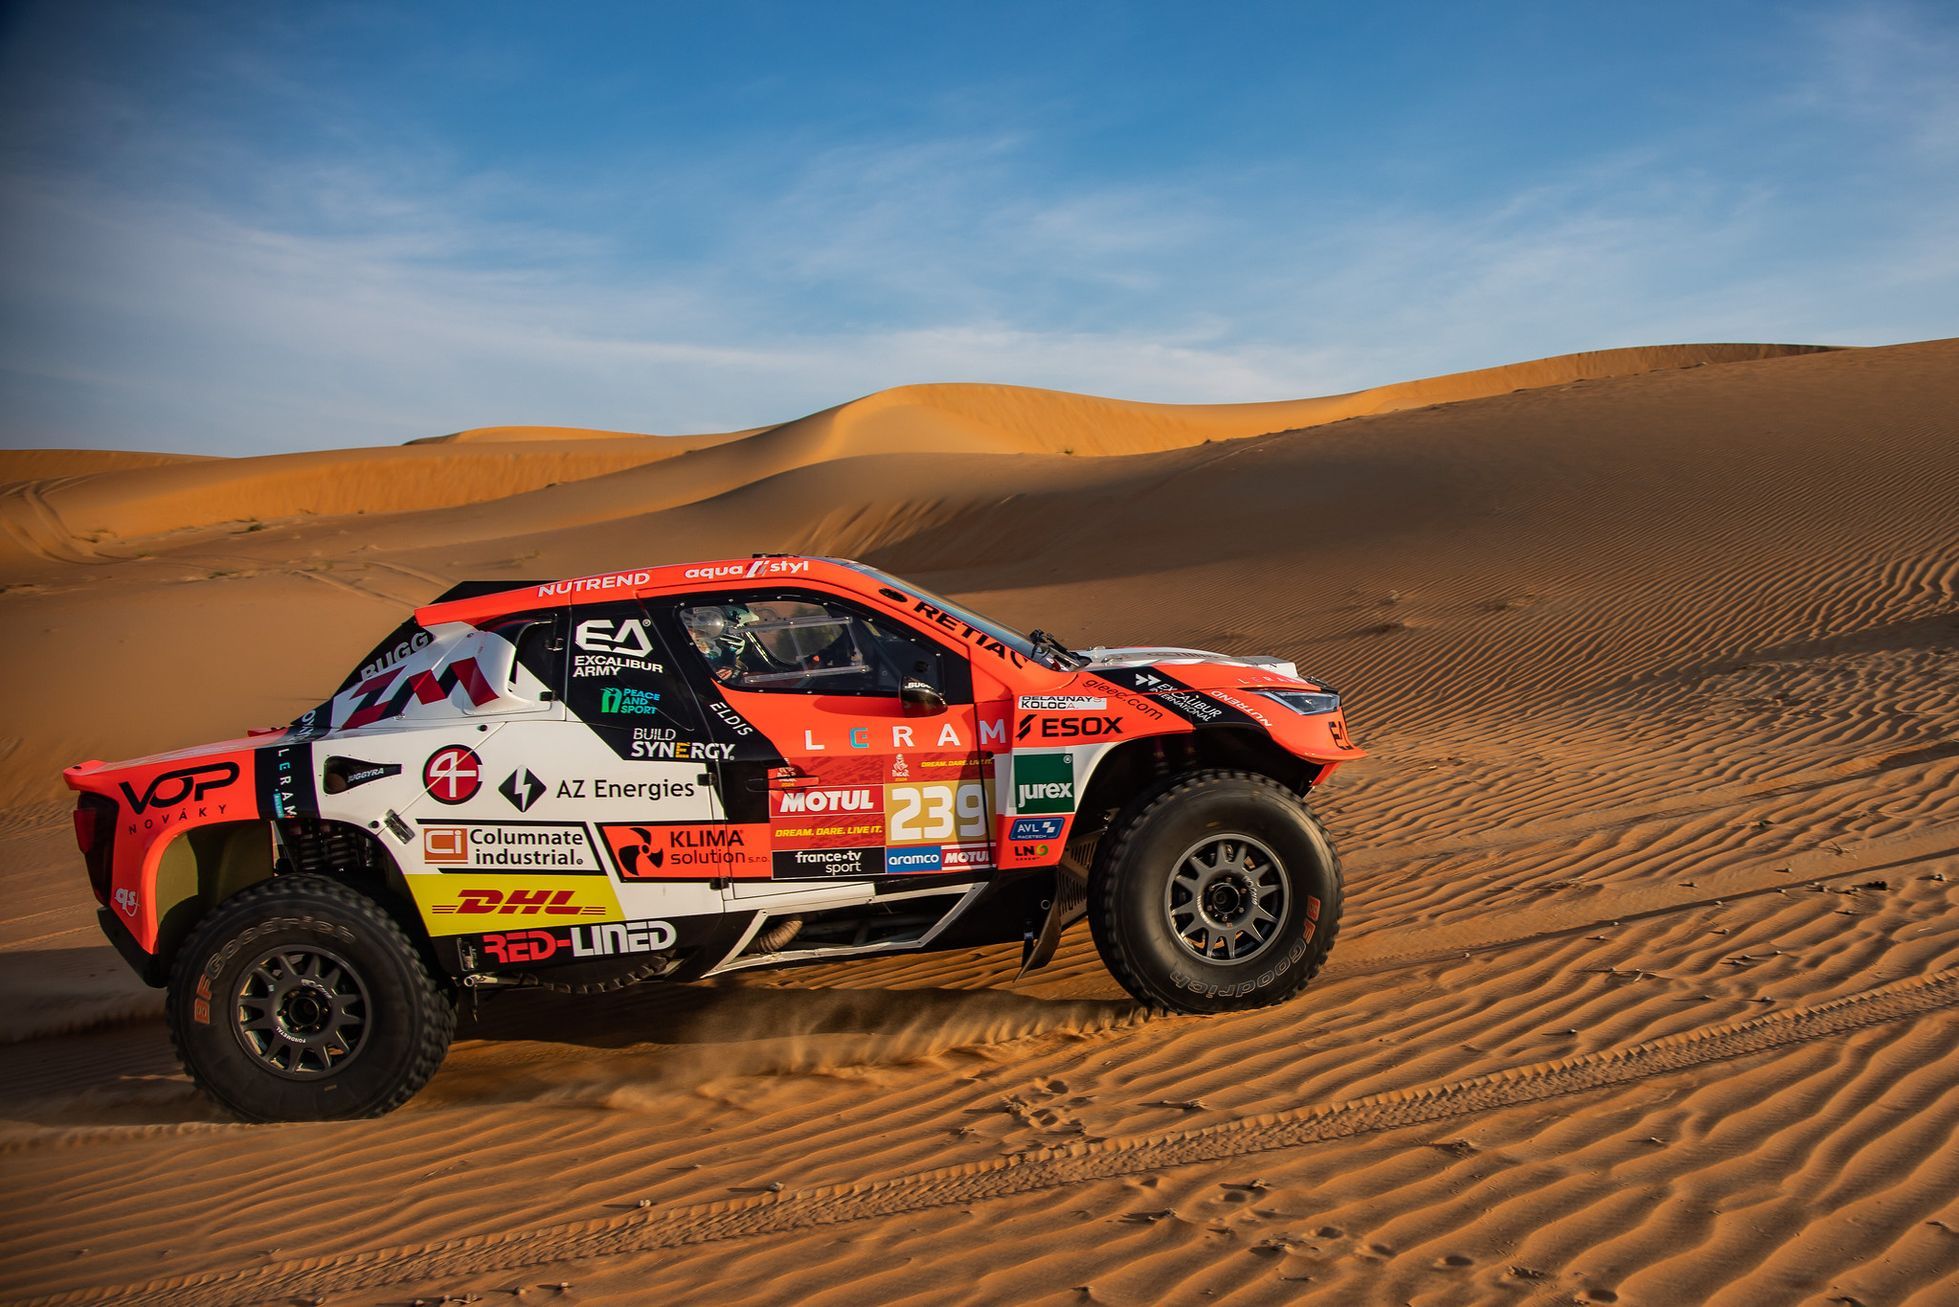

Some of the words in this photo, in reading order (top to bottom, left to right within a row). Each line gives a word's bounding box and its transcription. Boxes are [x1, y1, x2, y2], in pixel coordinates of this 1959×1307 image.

[685, 564, 743, 579] aqua
[770, 560, 809, 574] styl
[538, 573, 651, 597] NUTREND
[914, 602, 1006, 660] RETIA
[573, 666, 621, 678] ARMY
[574, 655, 664, 674] EXCALIBUR
[623, 688, 661, 701] PEACE
[623, 697, 649, 706] AND
[1083, 680, 1164, 720] gleec.com
[1157, 683, 1222, 718] EXCALIBUR
[620, 704, 658, 715] SPORT
[709, 701, 754, 737] ELDIS
[633, 728, 677, 741] BUILD
[1042, 716, 1124, 737] ESOX
[118, 761, 240, 815] VOP
[556, 780, 586, 799] AZ
[595, 778, 695, 801] Energies
[1018, 782, 1073, 808] jurex
[780, 789, 874, 813] MOTUL
[129, 804, 227, 835] NOVÁKY
[890, 784, 988, 841] 239
[470, 828, 583, 846] Columnate
[775, 828, 814, 837] DREAM.
[816, 827, 846, 836] DARE.
[847, 825, 869, 835] LIVE
[1018, 823, 1040, 833] AVL
[670, 829, 744, 848] KLIMA
[475, 848, 576, 865] industrial
[671, 849, 746, 865] solution
[889, 854, 940, 866] aramco
[825, 861, 862, 876] sport
[456, 889, 584, 914] DHL
